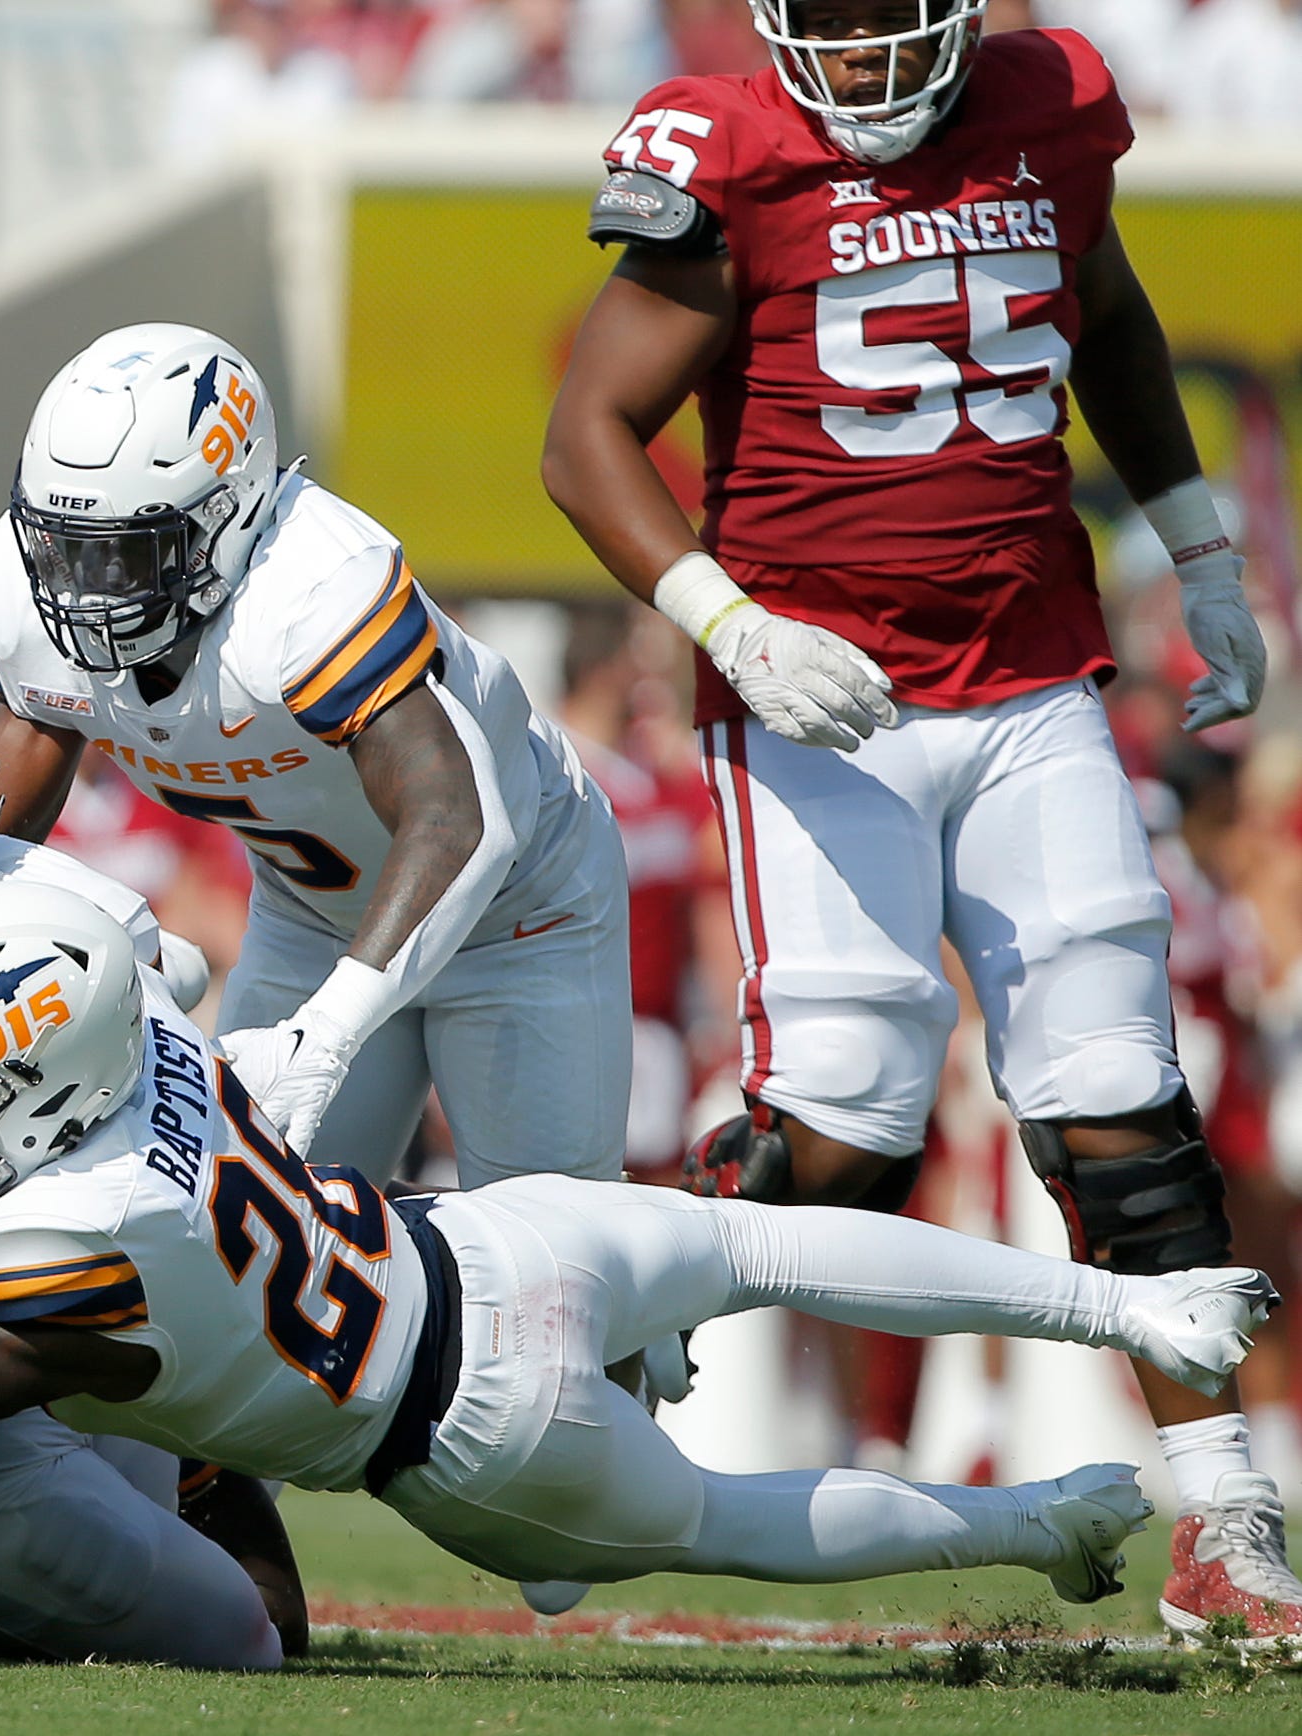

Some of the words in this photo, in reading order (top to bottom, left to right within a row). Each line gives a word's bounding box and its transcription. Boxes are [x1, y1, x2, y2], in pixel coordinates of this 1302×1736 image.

[603, 108, 714, 189] 55
[828, 177, 881, 208] XII
[828, 199, 1059, 274] SOONERS
[815, 250, 1072, 458] 55
[201, 373, 257, 477] 915
[49, 493, 98, 511] UTEP
[152, 781, 362, 892] 5
[146, 1017, 209, 1198] BAPTIST
